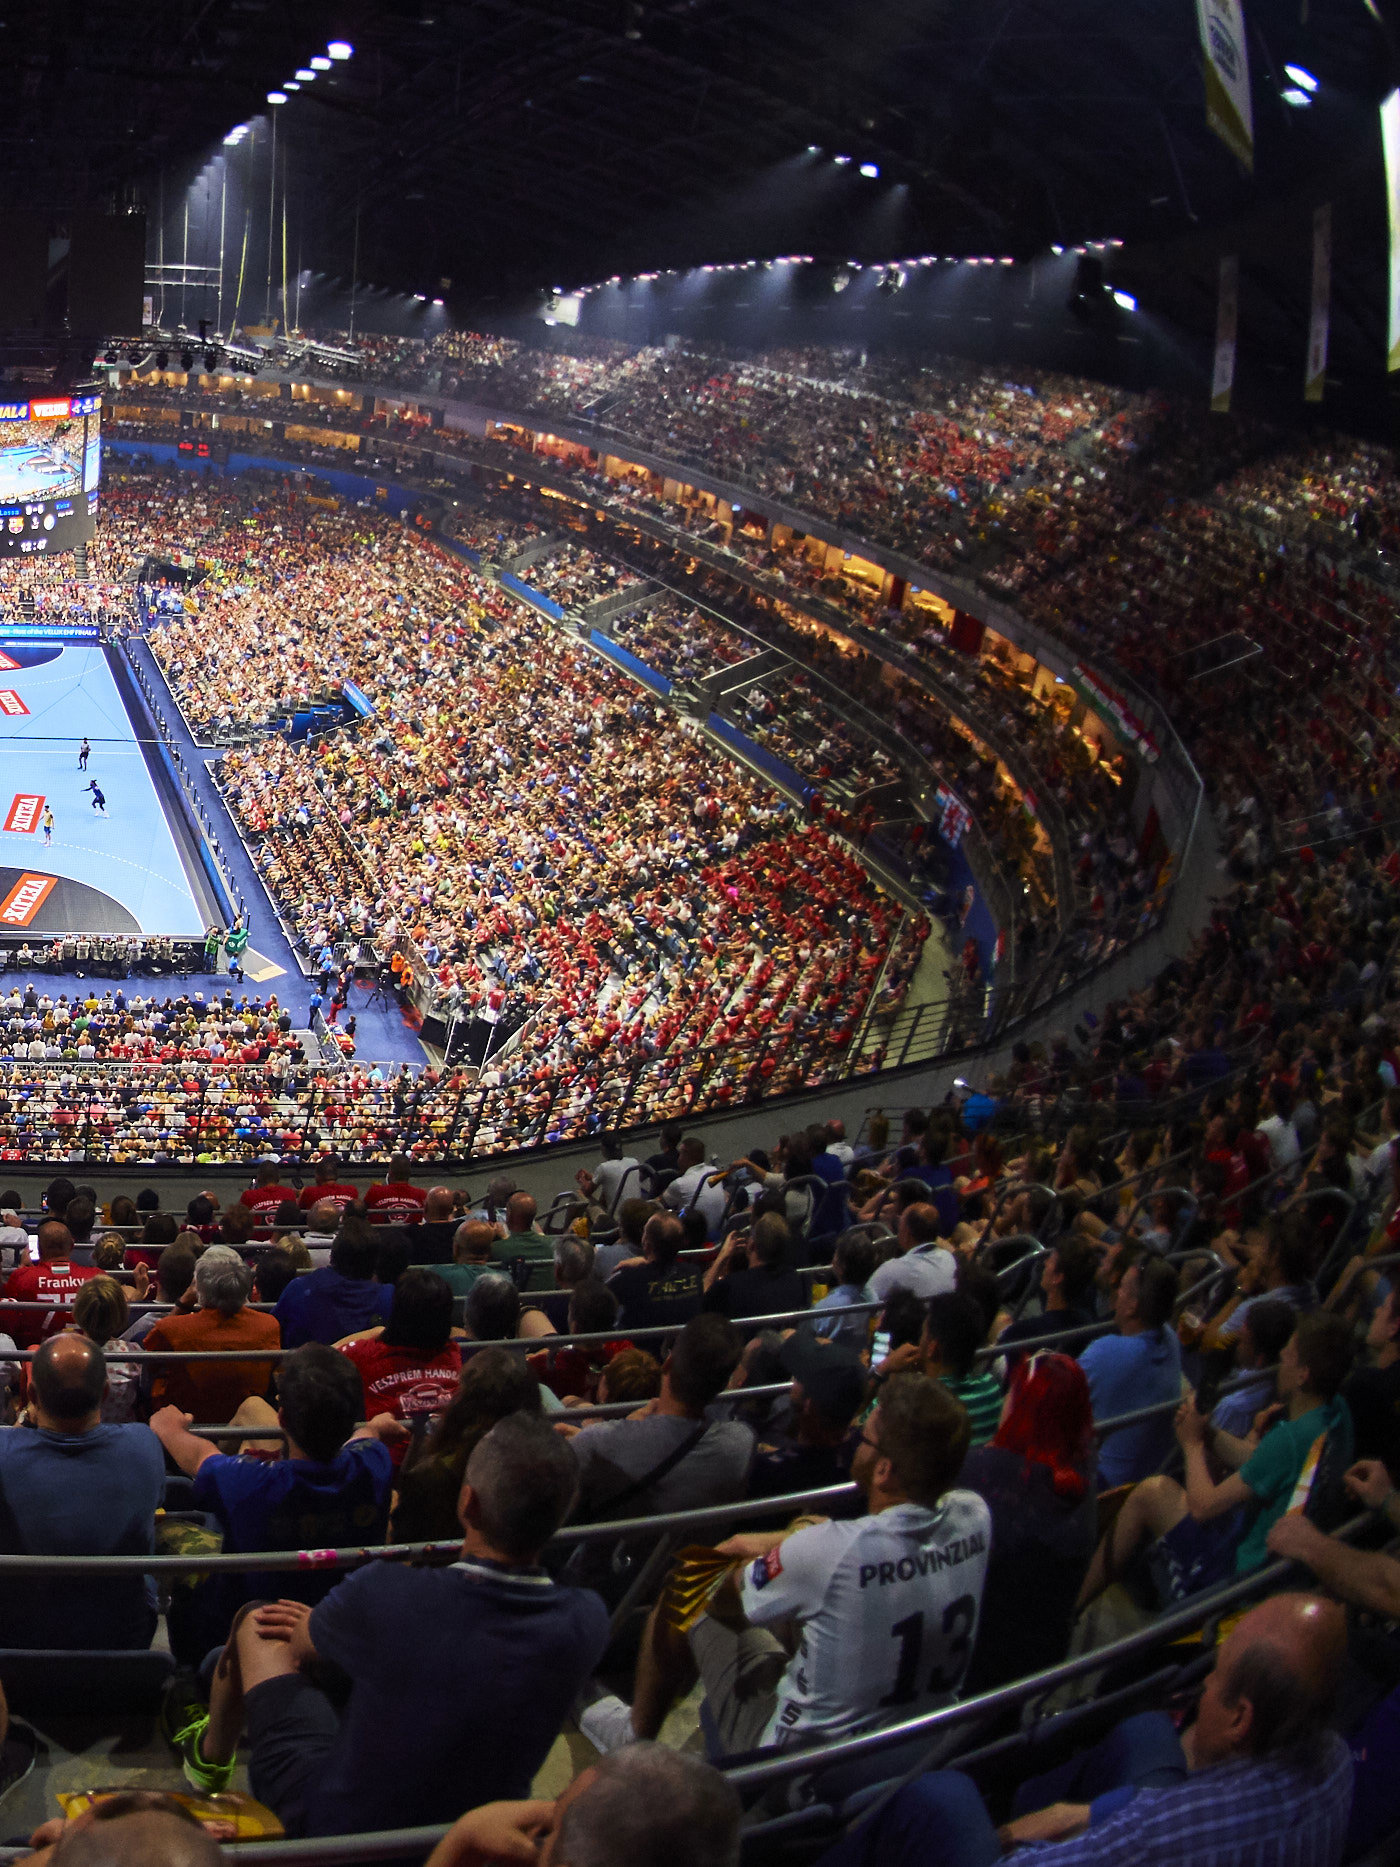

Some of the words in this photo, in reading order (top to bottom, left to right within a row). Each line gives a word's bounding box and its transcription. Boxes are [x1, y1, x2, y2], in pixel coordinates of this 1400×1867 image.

[11, 797, 39, 831] VELUX
[2, 879, 48, 921] VELUX
[860, 1533, 986, 1588] PROVINZIAL
[879, 1593, 976, 1708] 13
